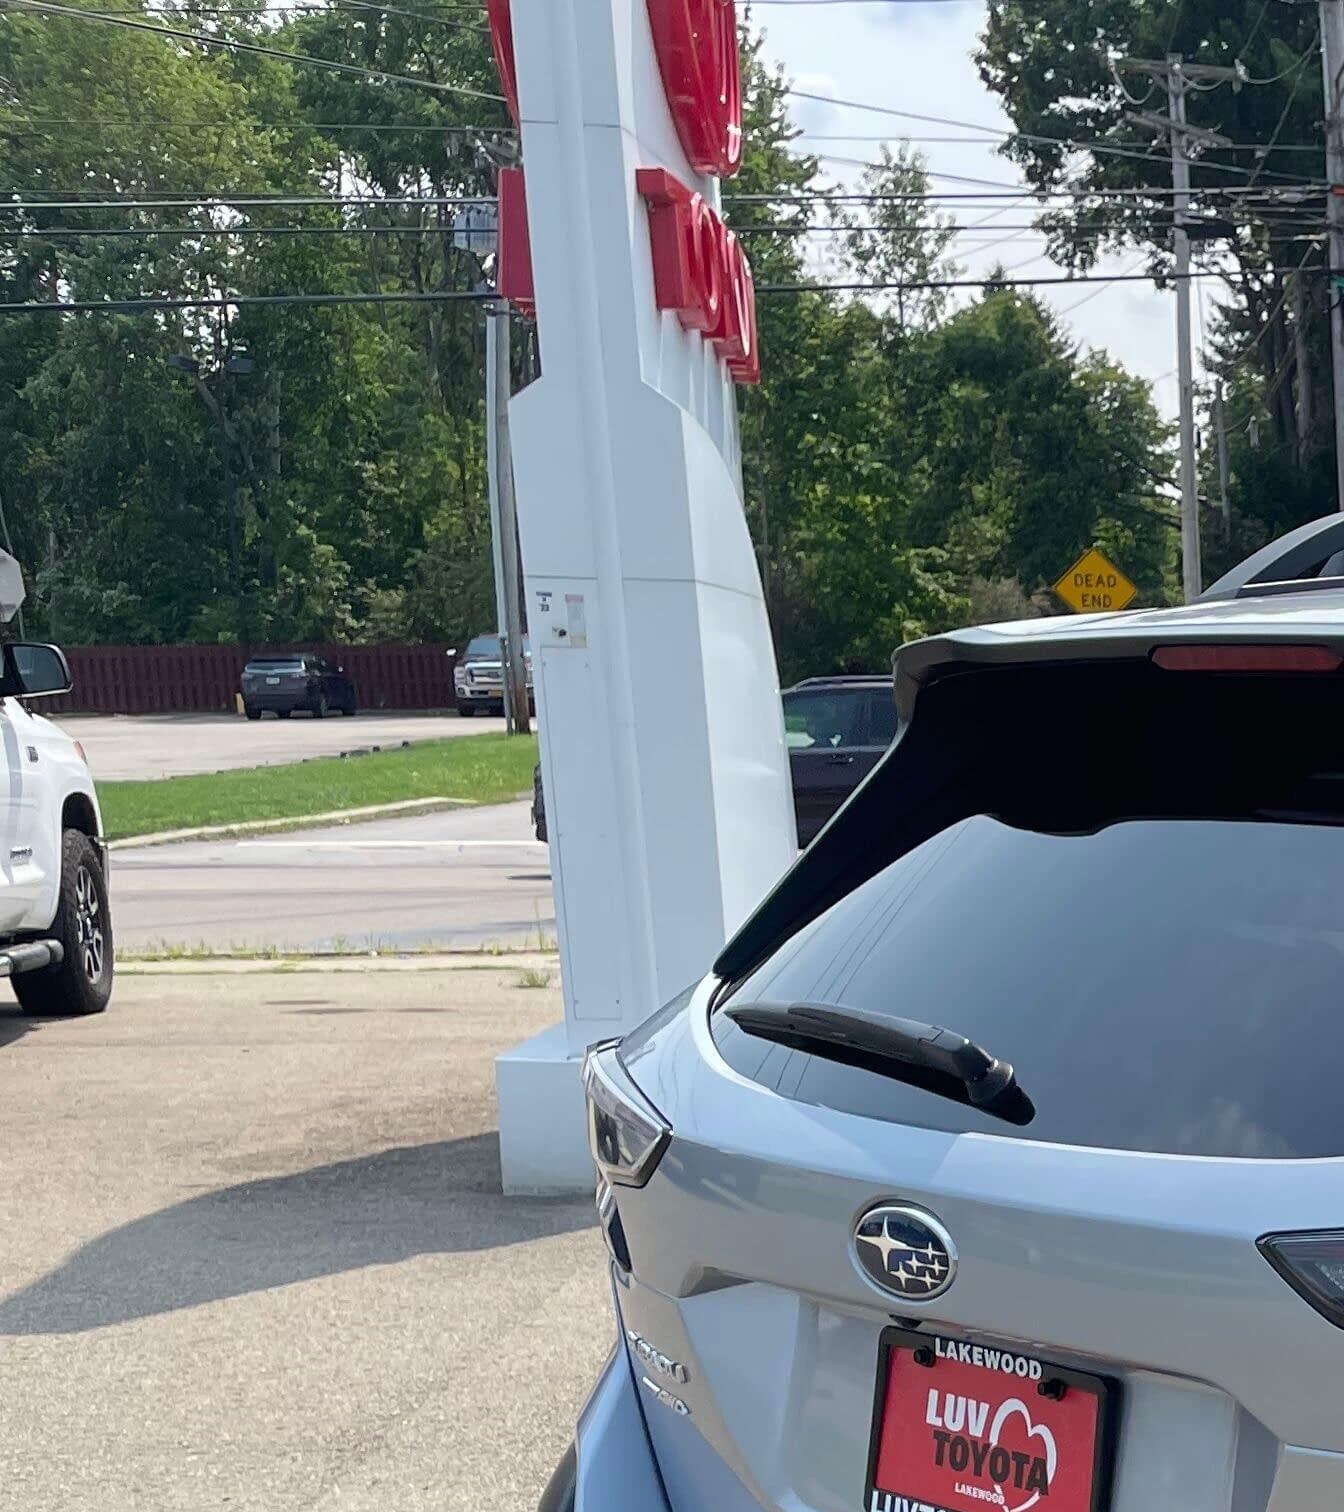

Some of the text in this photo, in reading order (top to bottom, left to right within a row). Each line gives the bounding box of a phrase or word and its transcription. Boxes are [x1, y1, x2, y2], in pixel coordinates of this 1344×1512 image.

[1073, 573, 1117, 588] DEAD
[1081, 593, 1112, 608] END
[934, 1337, 1043, 1381] LAKEWOOD
[925, 1388, 989, 1438] LUV
[933, 1430, 1049, 1496] TOYOTA
[954, 1482, 1006, 1505] LAKEWOOD
